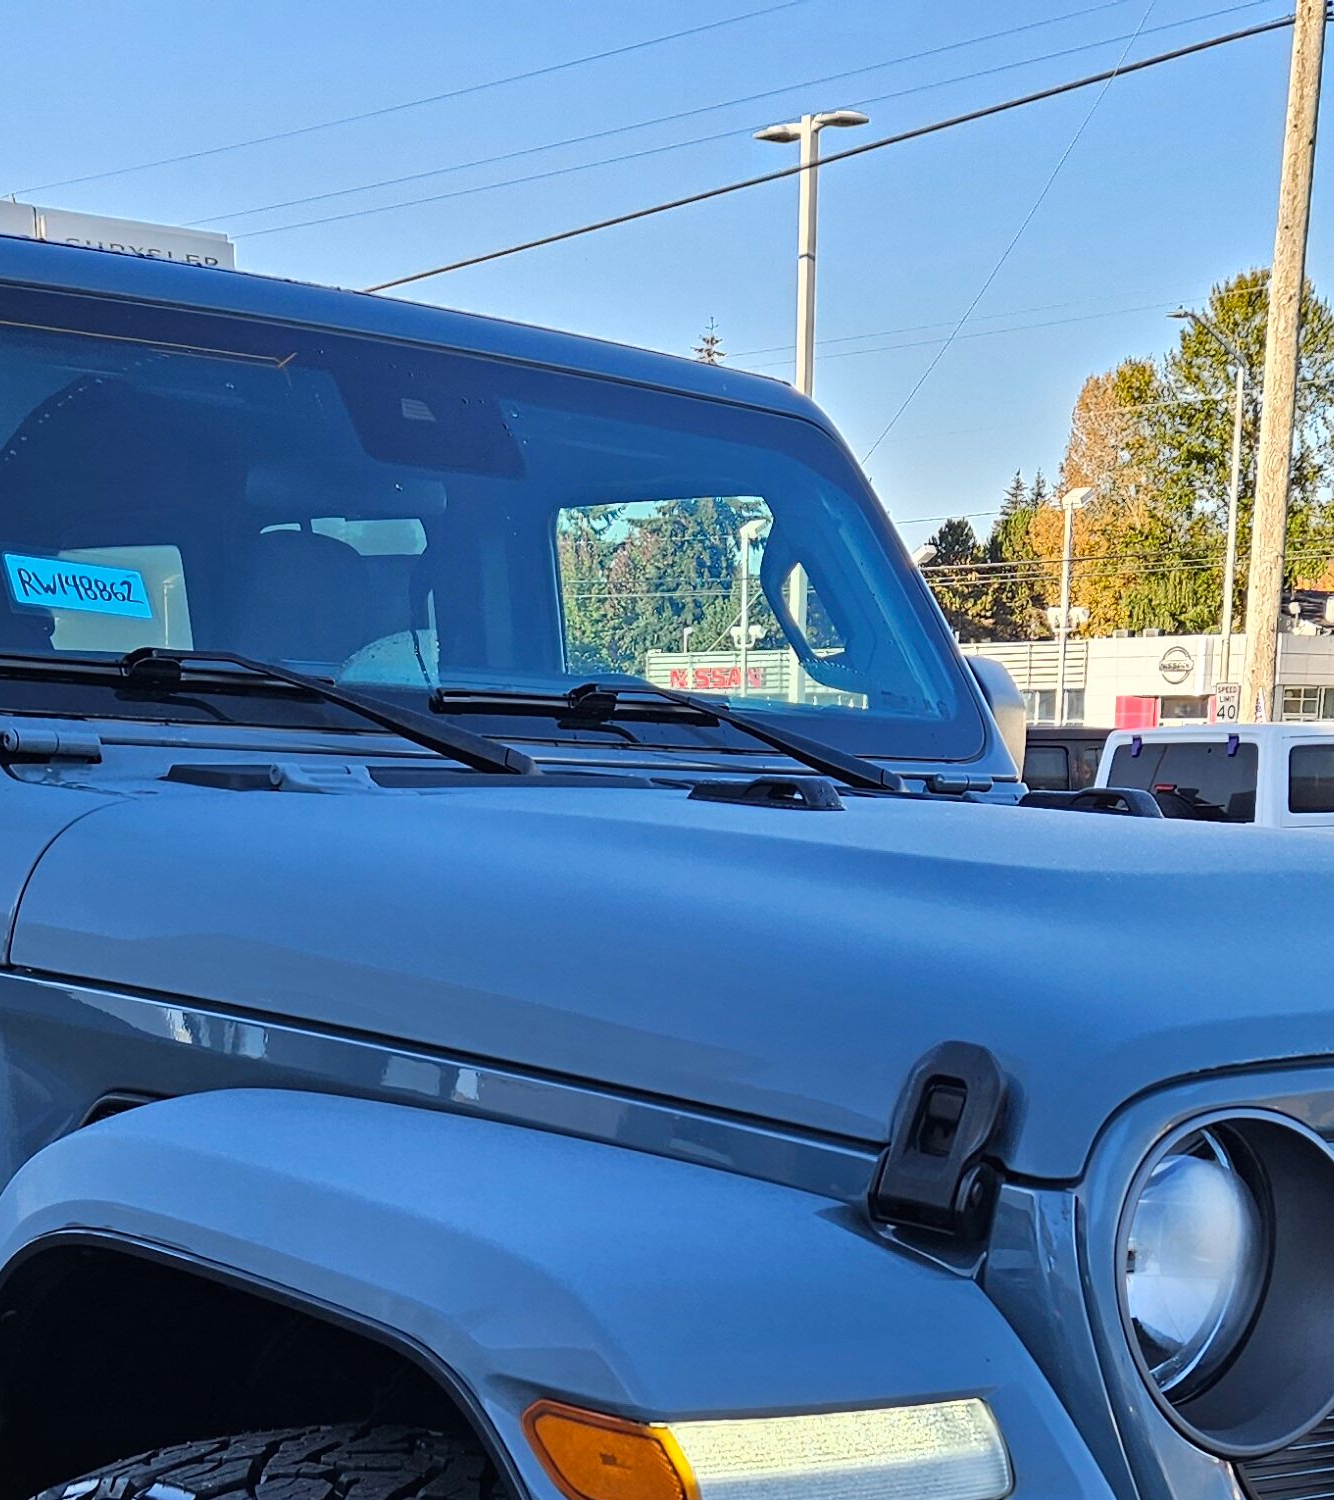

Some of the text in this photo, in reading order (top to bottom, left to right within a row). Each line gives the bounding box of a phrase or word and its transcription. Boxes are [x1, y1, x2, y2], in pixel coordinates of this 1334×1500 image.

[17, 567, 144, 604] RW148862
[670, 667, 765, 689] NSSAN
[1218, 686, 1237, 694] SPEED
[1220, 695, 1235, 703] LIMIT
[1217, 704, 1236, 719] 40
